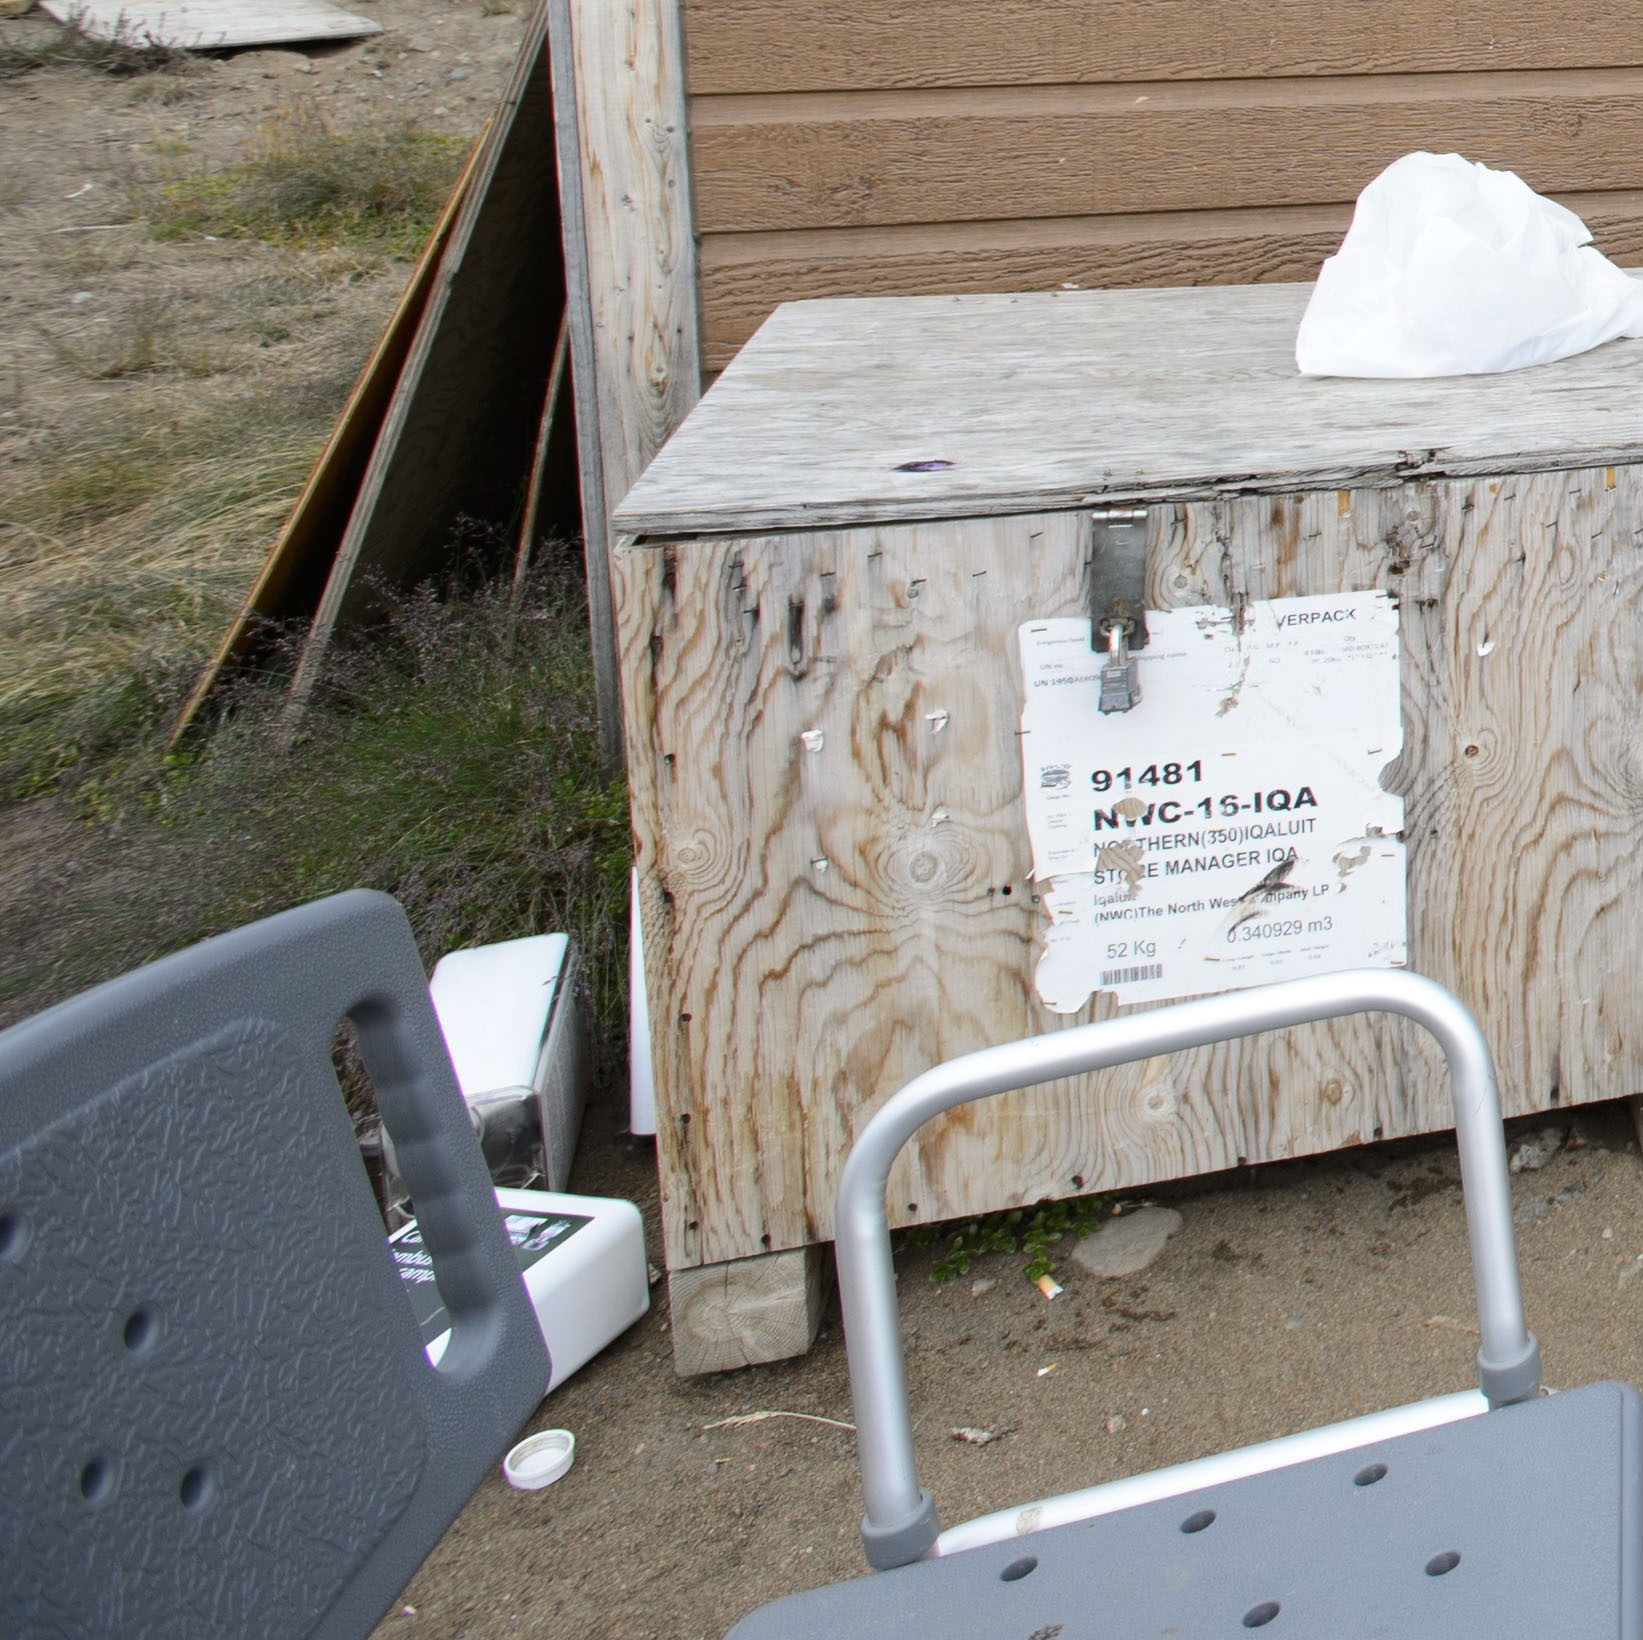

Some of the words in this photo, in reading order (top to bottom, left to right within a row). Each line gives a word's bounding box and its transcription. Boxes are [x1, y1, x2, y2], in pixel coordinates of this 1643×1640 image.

[1091, 760, 1203, 792] 91481
[1094, 818, 1317, 858] NTHERN(350)IQALUIT
[1165, 850, 1262, 876] MANAGER
[1267, 846, 1299, 865] IQA
[1168, 898, 1206, 915] North
[1209, 895, 1244, 910] Wes
[1313, 883, 1330, 897] LP
[1107, 942, 1128, 959] 52
[1134, 940, 1156, 958] Kg
[1226, 919, 1303, 944] 0.340929
[1308, 915, 1333, 932] m3
